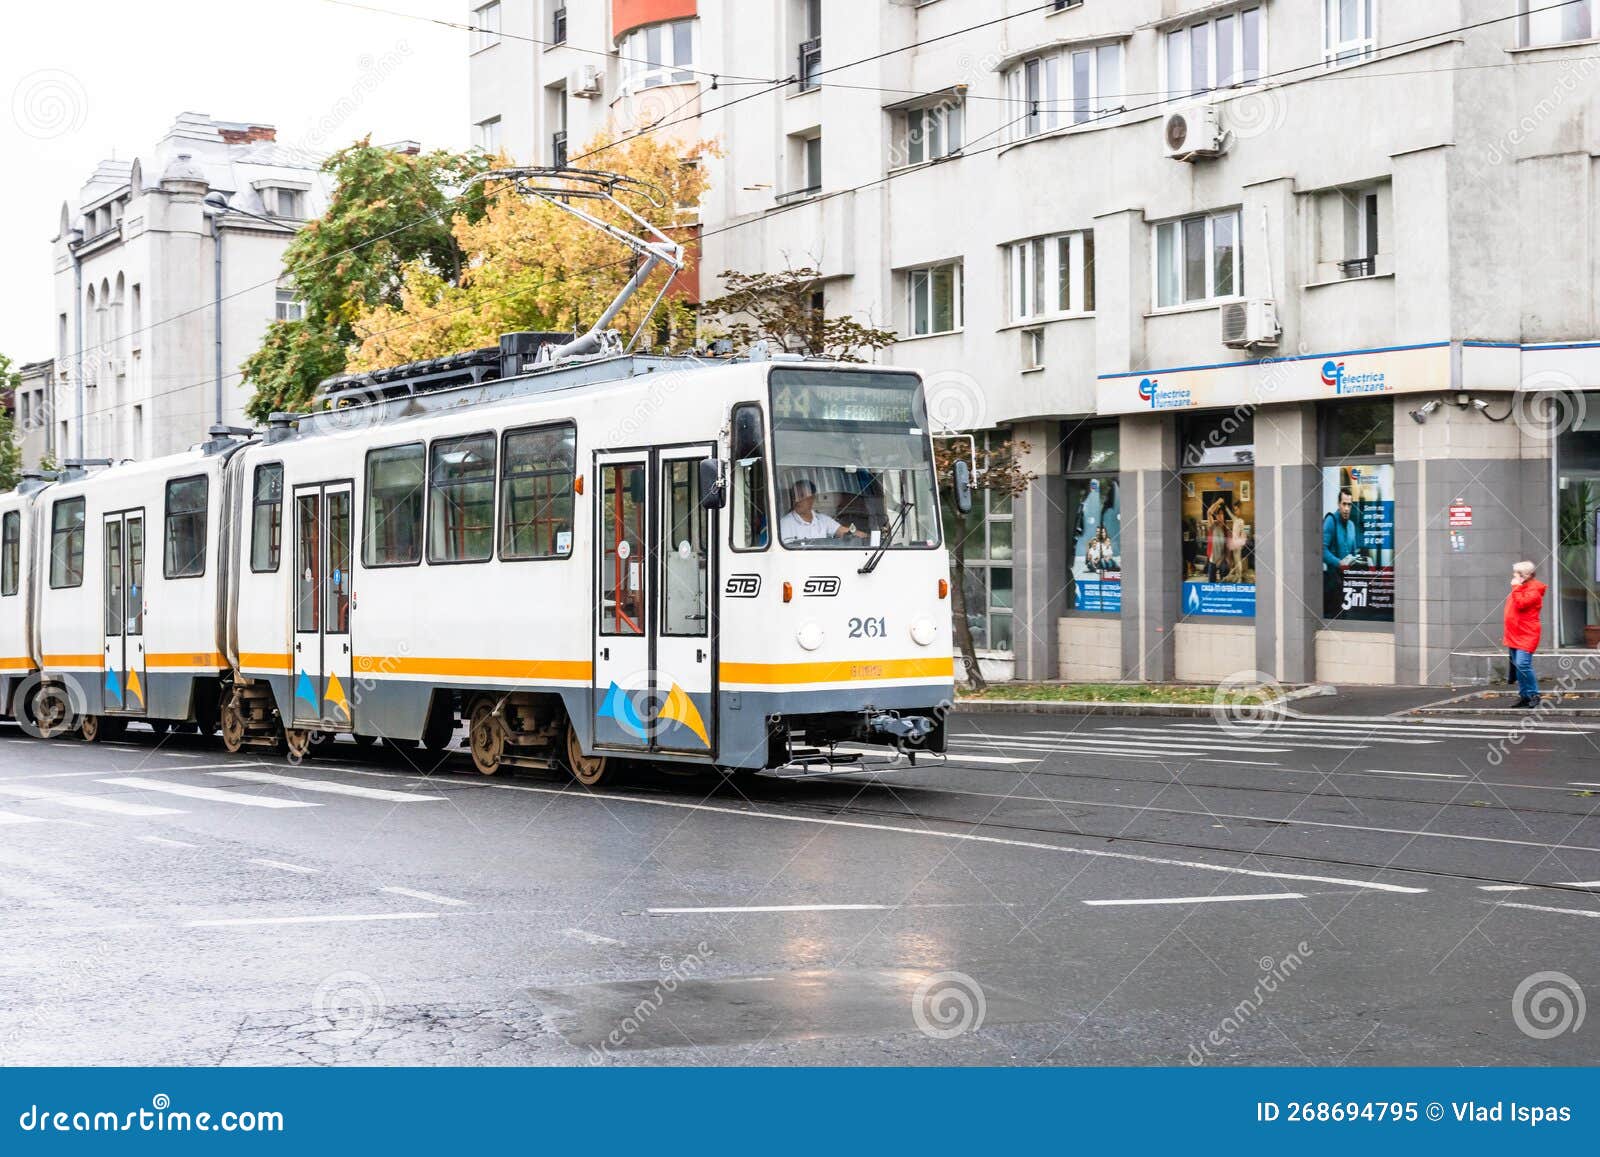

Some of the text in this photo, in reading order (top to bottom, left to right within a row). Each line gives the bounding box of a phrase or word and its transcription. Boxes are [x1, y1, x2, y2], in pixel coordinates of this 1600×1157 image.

[1343, 373, 1385, 384] electrica
[1155, 389, 1191, 399] electrica
[1342, 382, 1385, 393] furnizare
[774, 384, 811, 418] 44
[1155, 398, 1191, 408] furnizare
[725, 576, 759, 596] STB
[803, 578, 839, 595] STB
[1341, 587, 1368, 610] 3in1
[848, 617, 888, 638] 261
